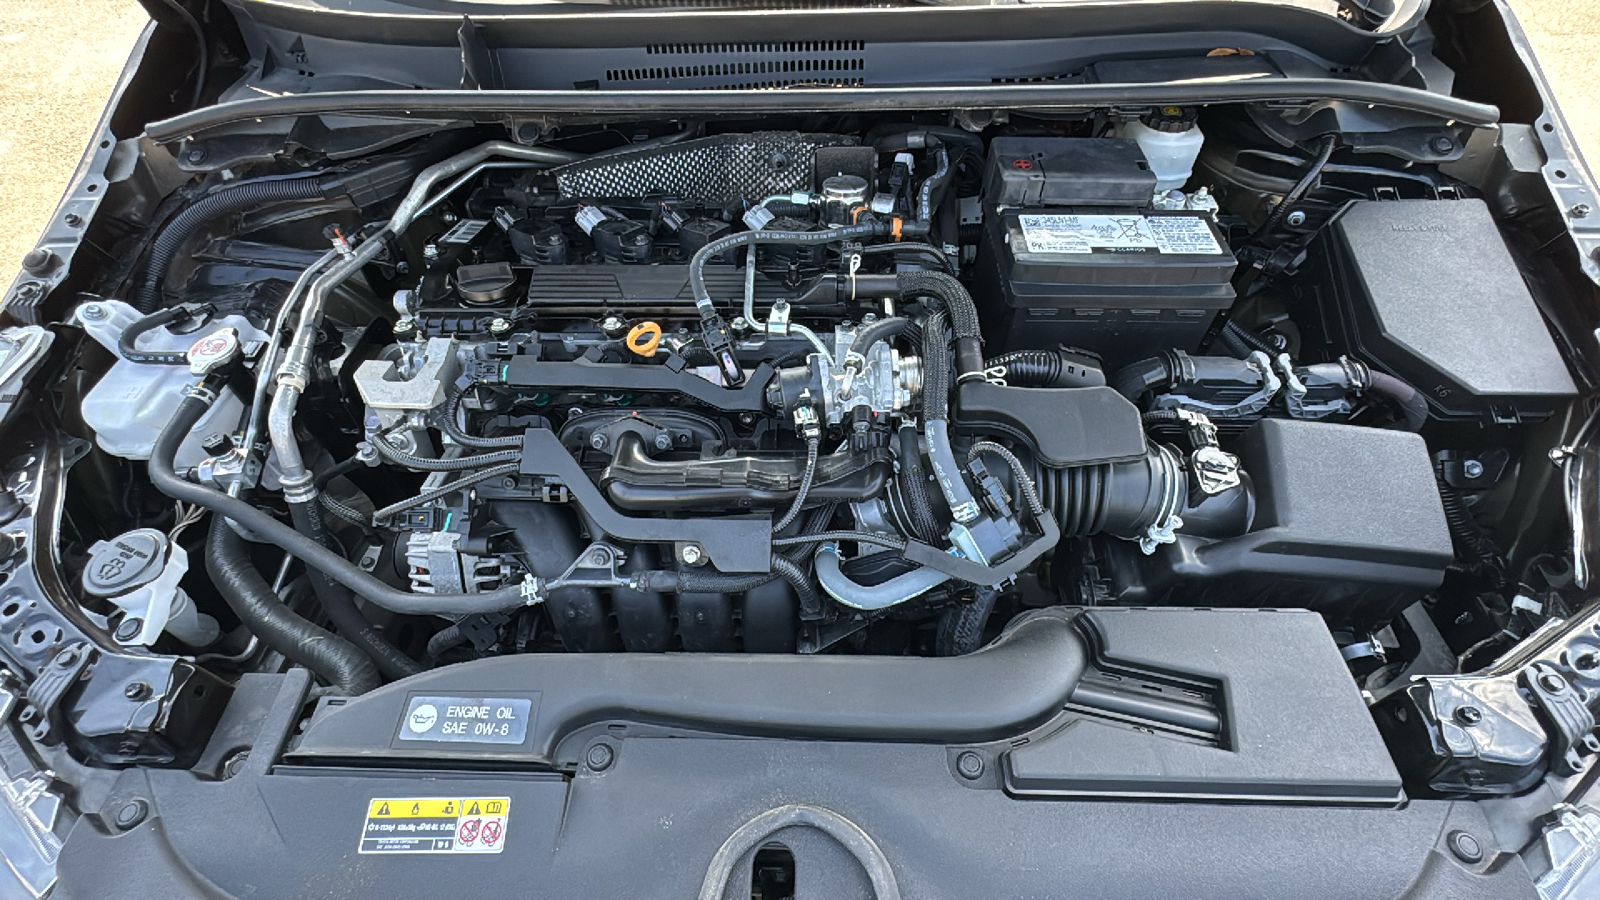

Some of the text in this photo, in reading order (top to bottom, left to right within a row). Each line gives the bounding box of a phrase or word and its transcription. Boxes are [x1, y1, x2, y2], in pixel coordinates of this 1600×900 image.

[446, 706, 516, 719] ENGINE OIL
[442, 721, 509, 736] SAE 0W-8
